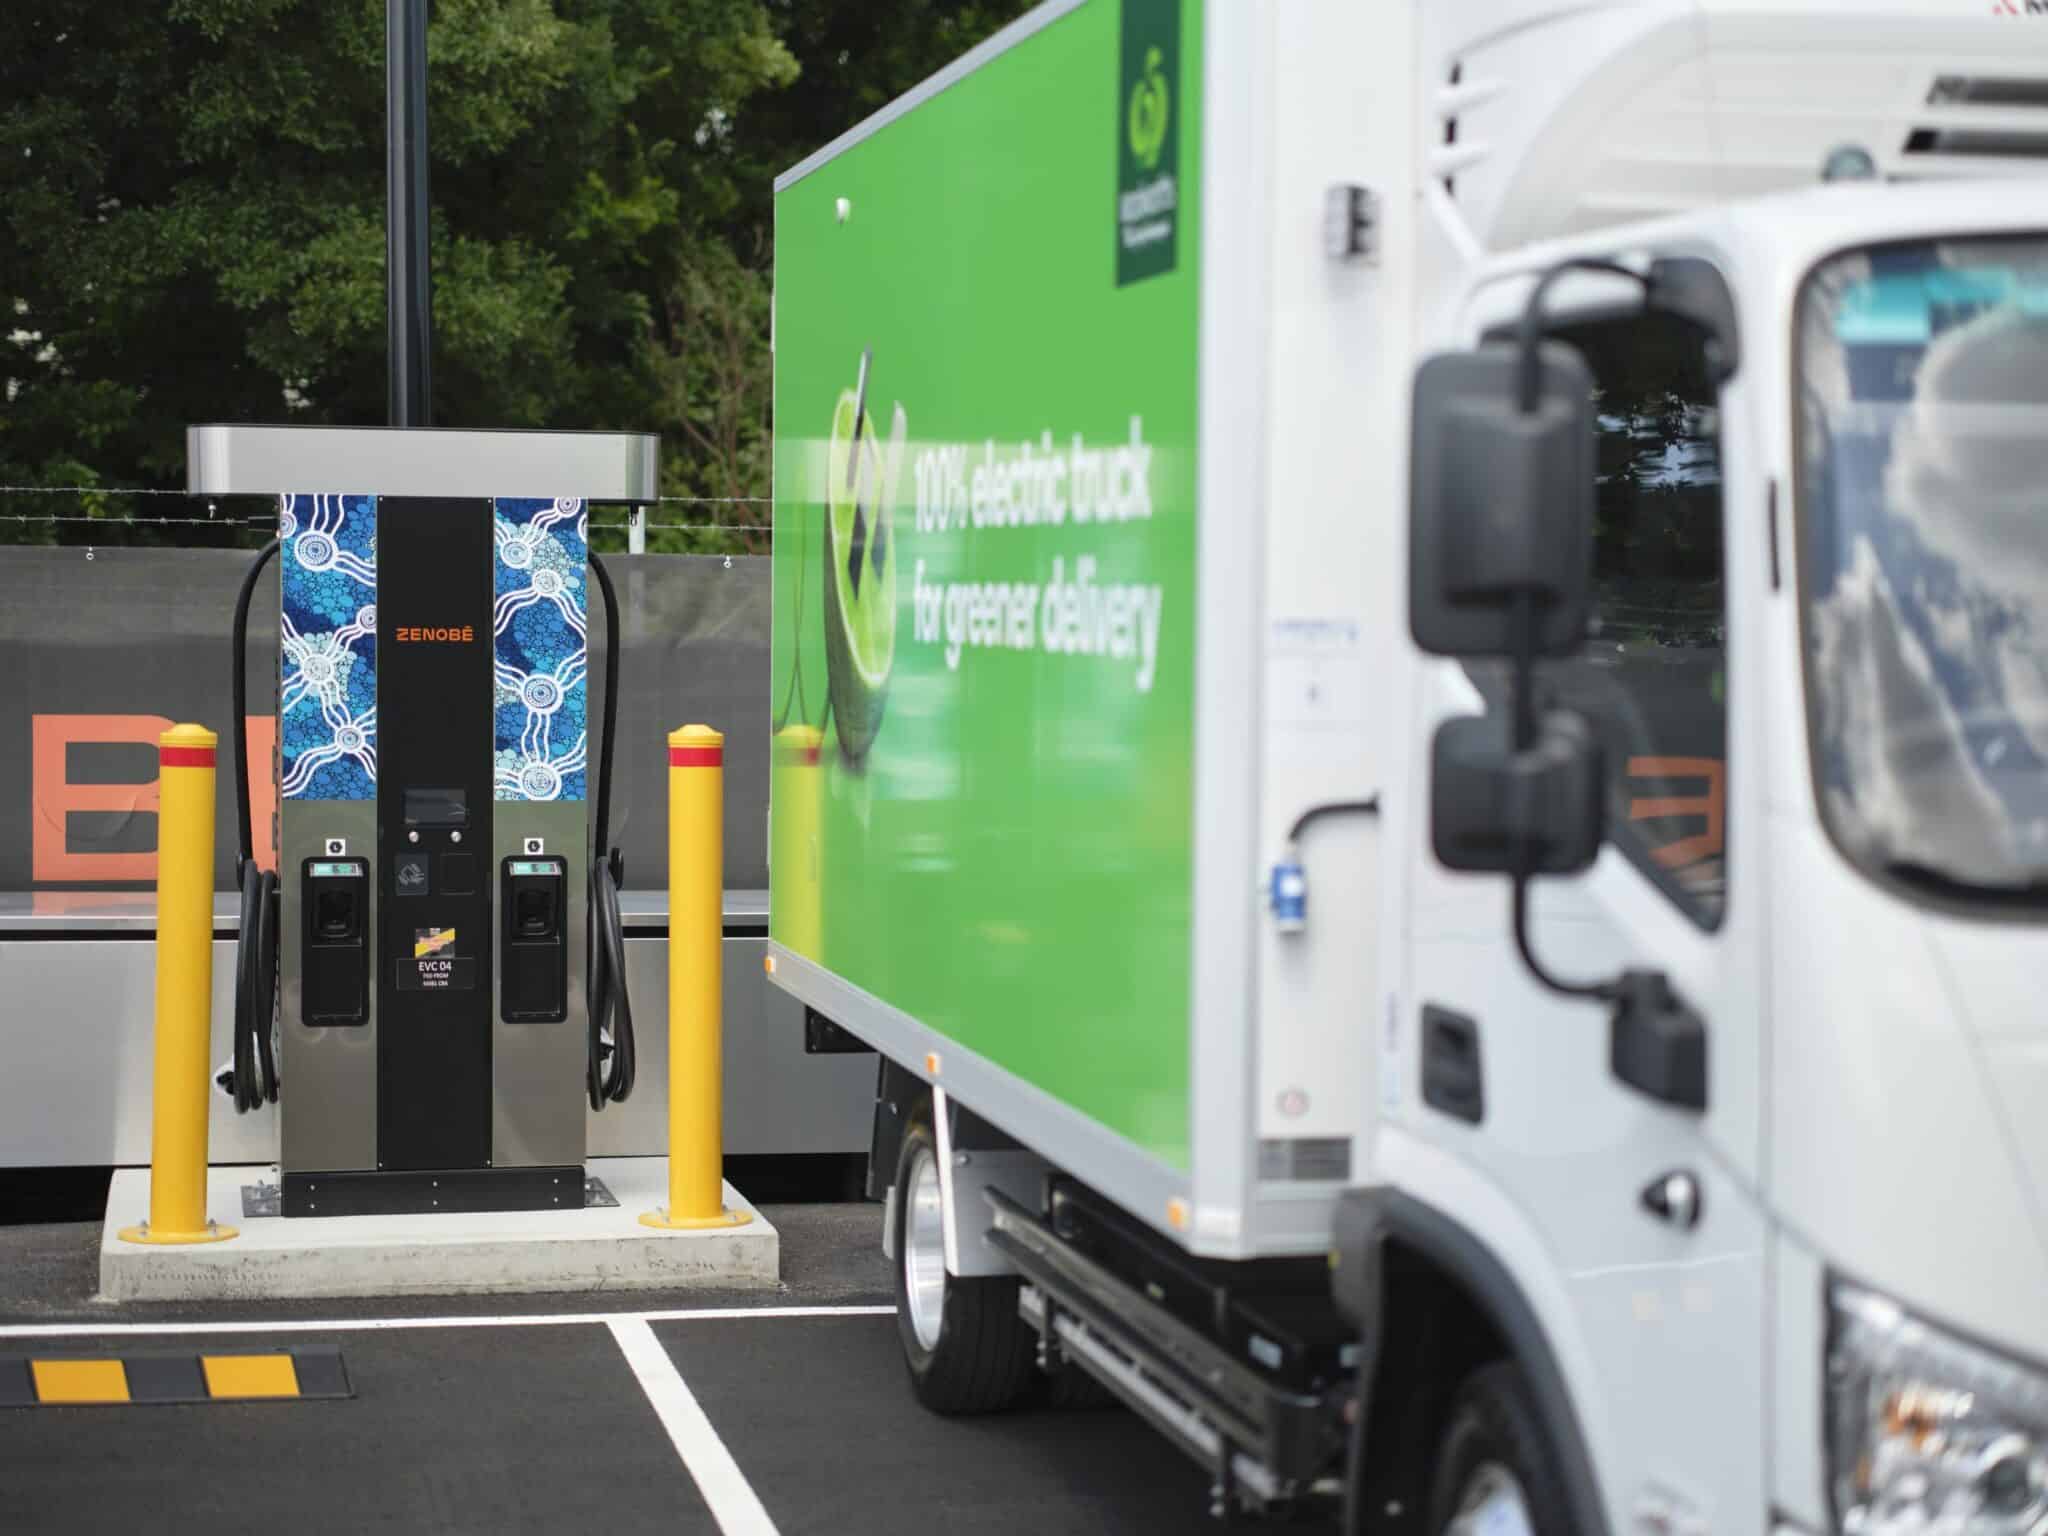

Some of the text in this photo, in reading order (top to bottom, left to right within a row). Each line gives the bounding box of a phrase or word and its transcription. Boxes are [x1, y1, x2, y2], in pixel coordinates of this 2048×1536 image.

[970, 428, 1067, 530] electric
[1071, 414, 1153, 525] truck
[914, 554, 1163, 694] for greener delivery
[418, 961, 452, 972] EVC 04
